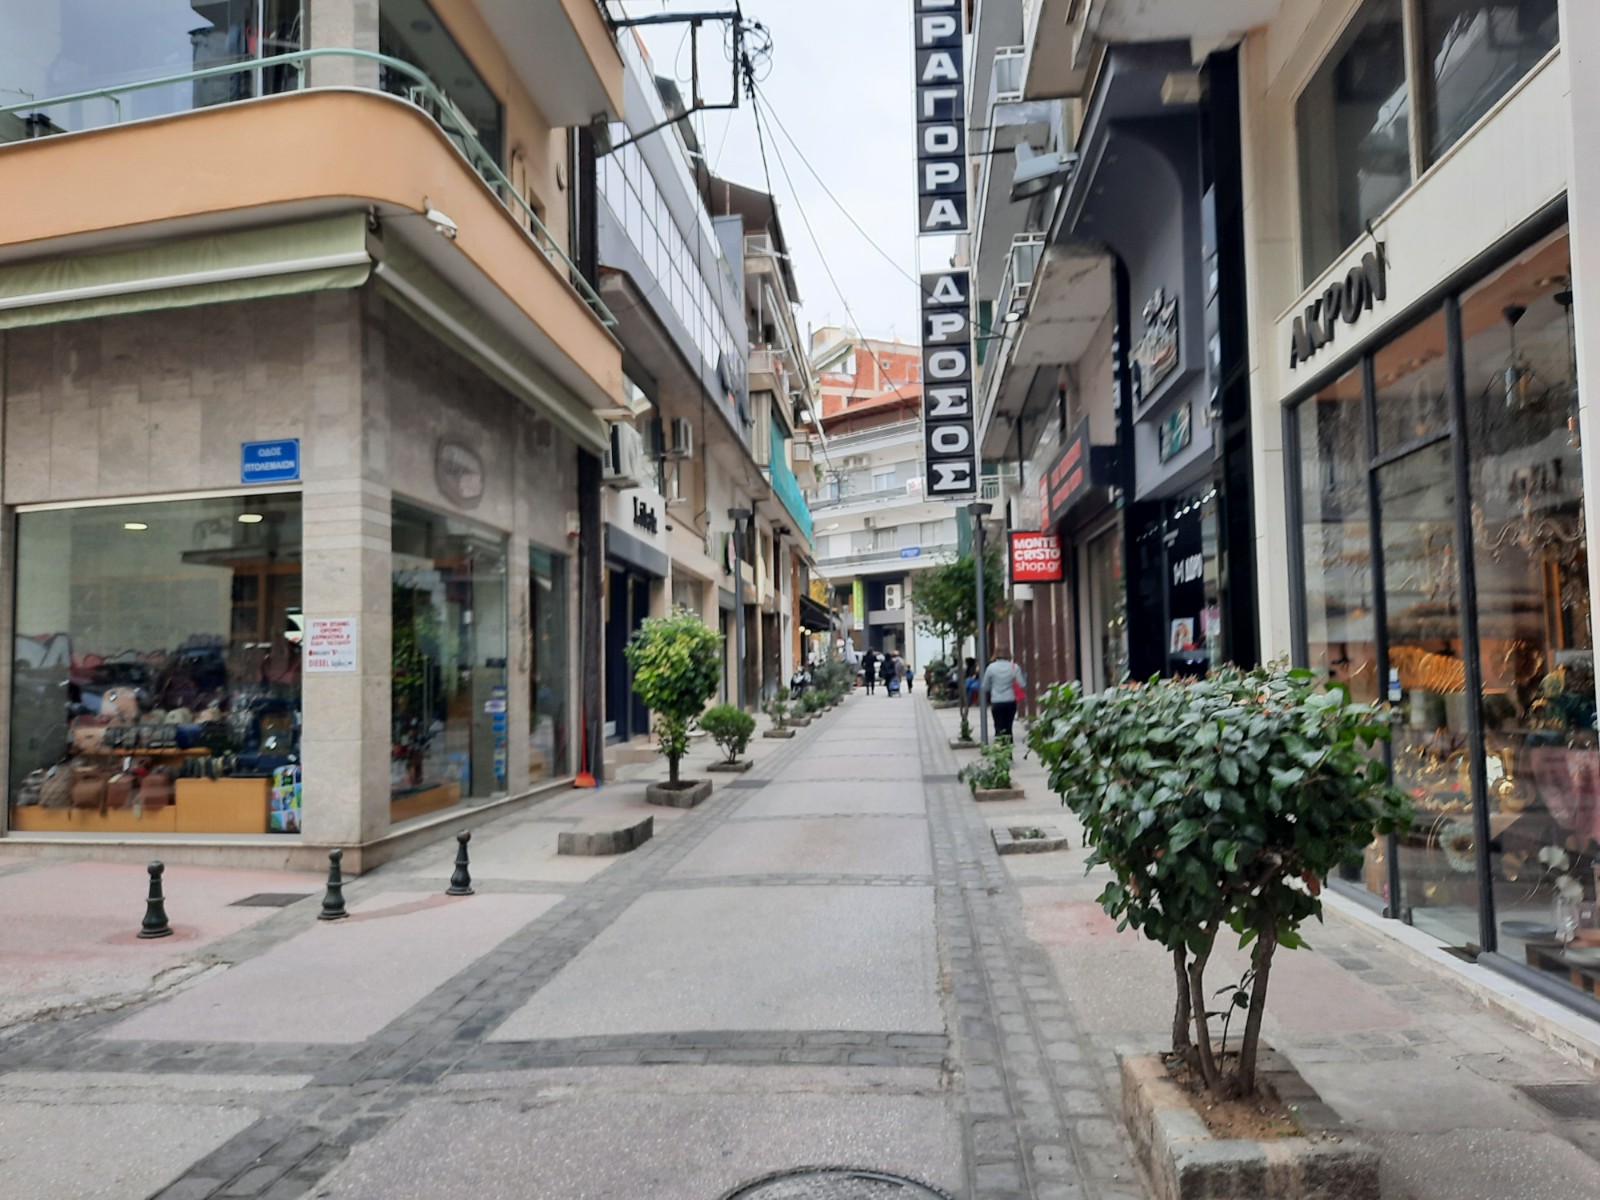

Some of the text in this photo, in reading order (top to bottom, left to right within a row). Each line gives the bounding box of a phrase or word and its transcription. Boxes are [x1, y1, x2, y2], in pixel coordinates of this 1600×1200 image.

[921, 0, 962, 228] ΡΑΓΟΡΑ
[926, 275, 971, 491] ΔΡΟΣΟΣ
[258, 447, 282, 457] ΟΔΟΣ
[1013, 536, 1057, 549] MONTE
[1014, 548, 1060, 560] CRISTO
[1015, 560, 1060, 573] shop.gr
[308, 659, 329, 667] DIESEL
